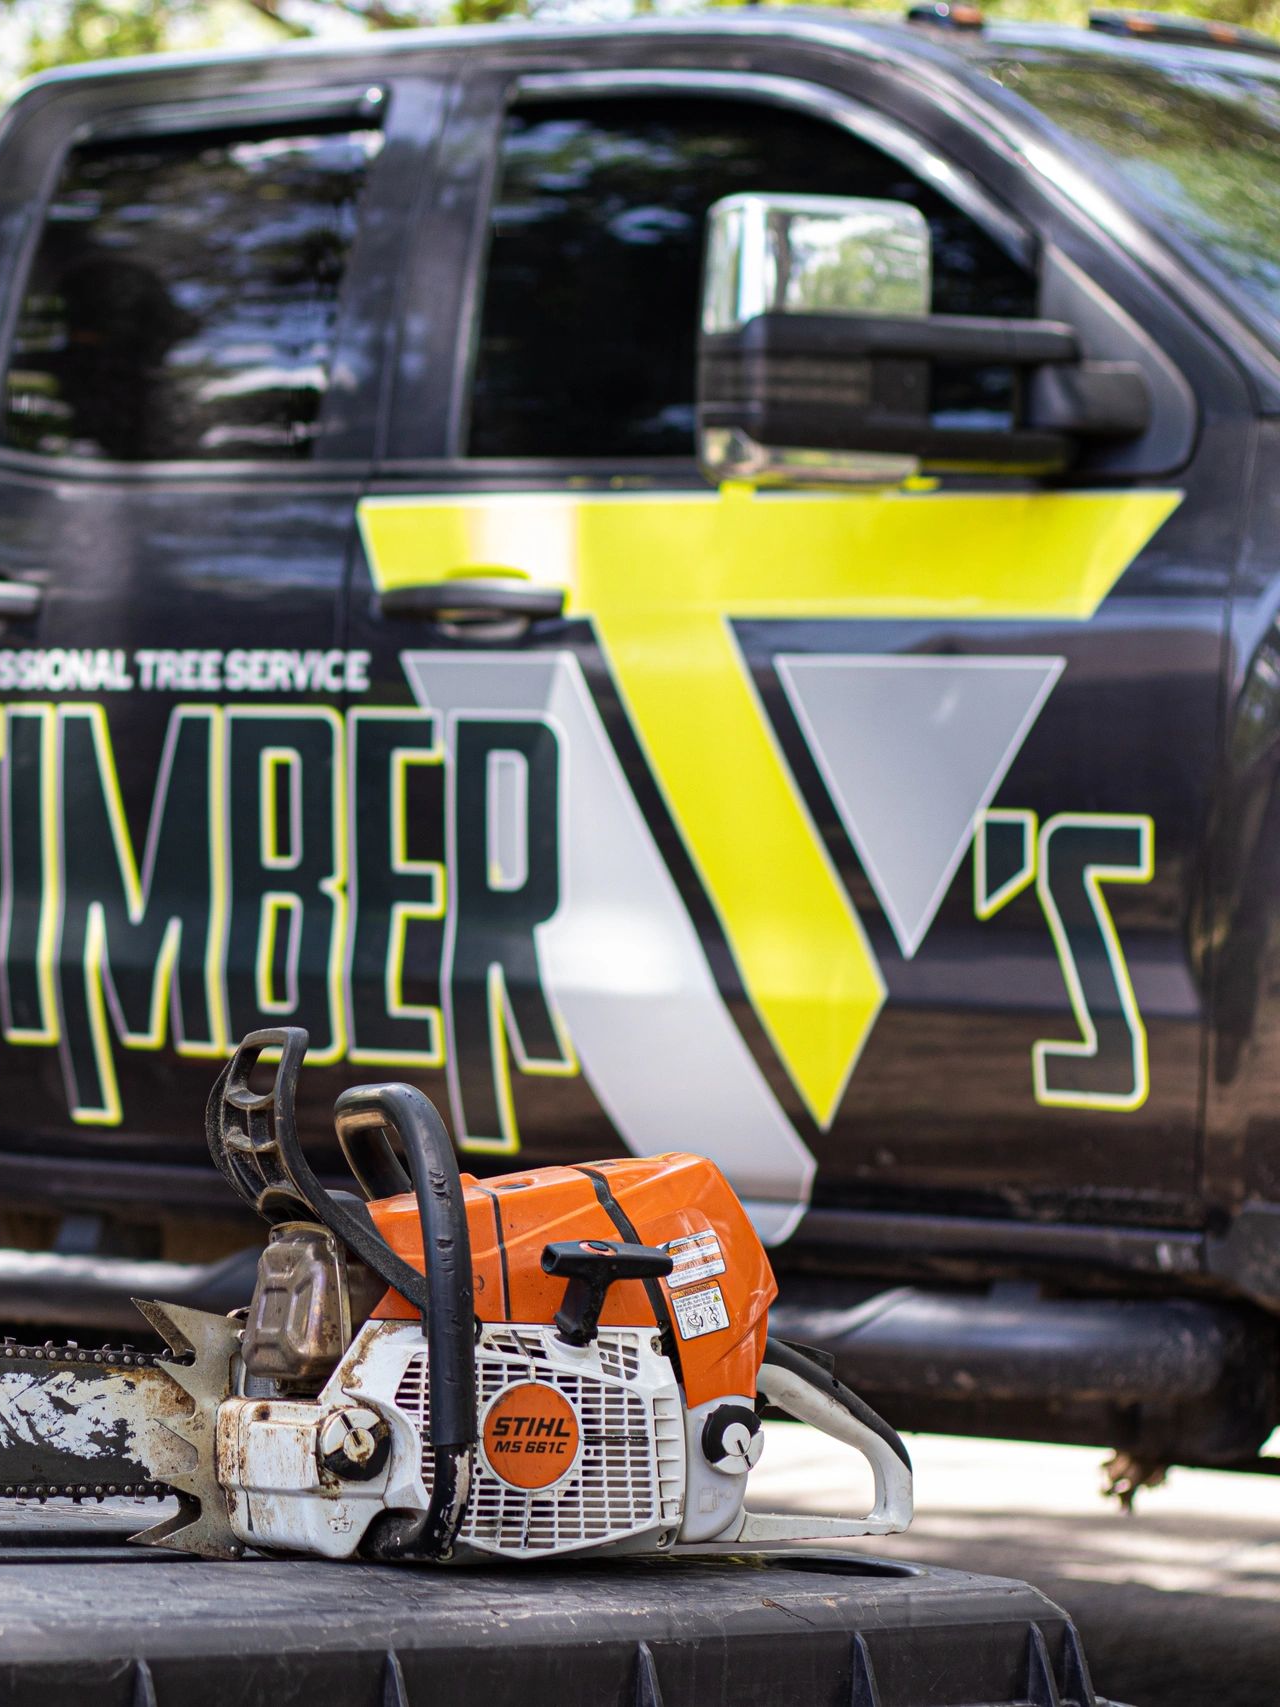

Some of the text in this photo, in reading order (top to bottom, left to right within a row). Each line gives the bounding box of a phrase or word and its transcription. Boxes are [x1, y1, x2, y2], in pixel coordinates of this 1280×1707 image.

[135, 650, 221, 691] TREE
[224, 650, 371, 692] SERVICE
[492, 1417, 571, 1437] STIHL
[494, 1440, 522, 1453] MS
